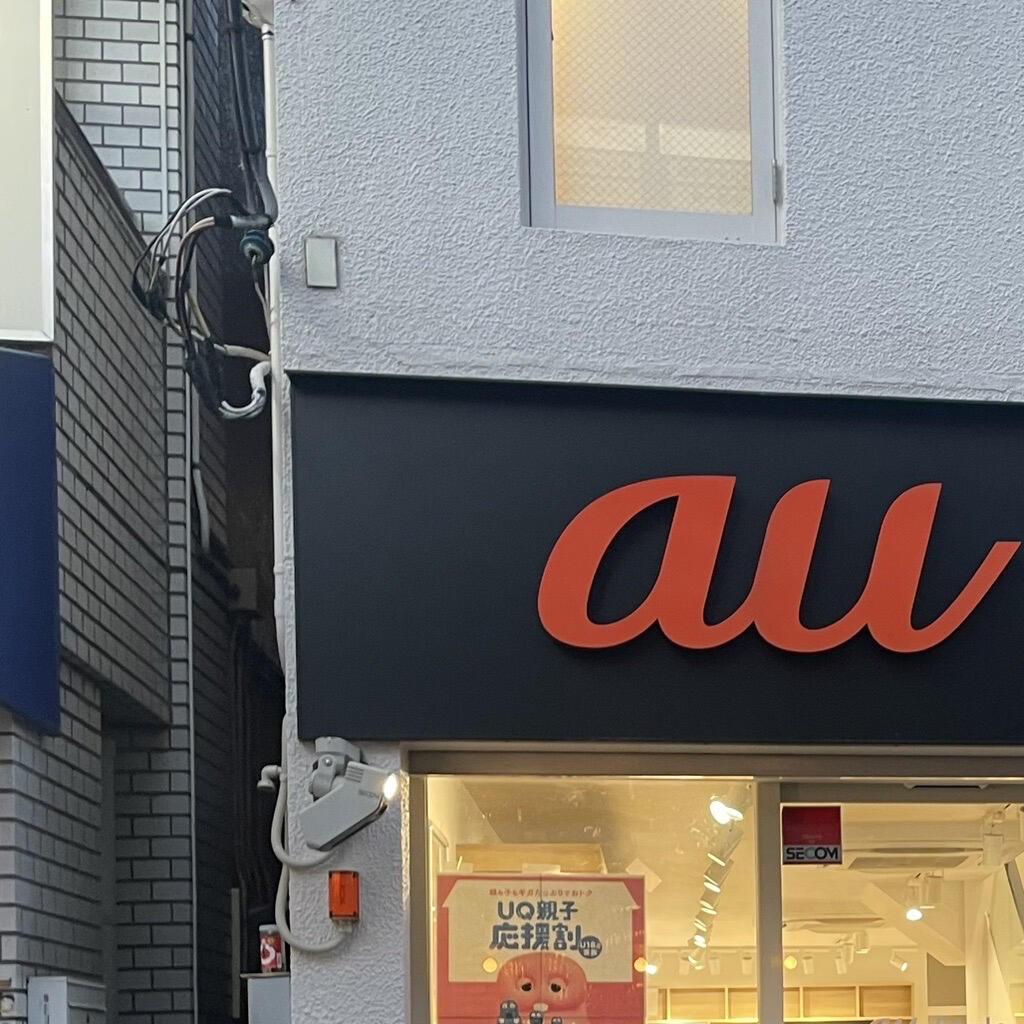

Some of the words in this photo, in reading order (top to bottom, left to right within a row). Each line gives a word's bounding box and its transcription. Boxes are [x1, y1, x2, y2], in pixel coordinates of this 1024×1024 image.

[537, 475, 1021, 653] au
[786, 846, 839, 861] SECOM
[497, 901, 578, 920] UQ親子
[489, 923, 582, 951] 応援割
